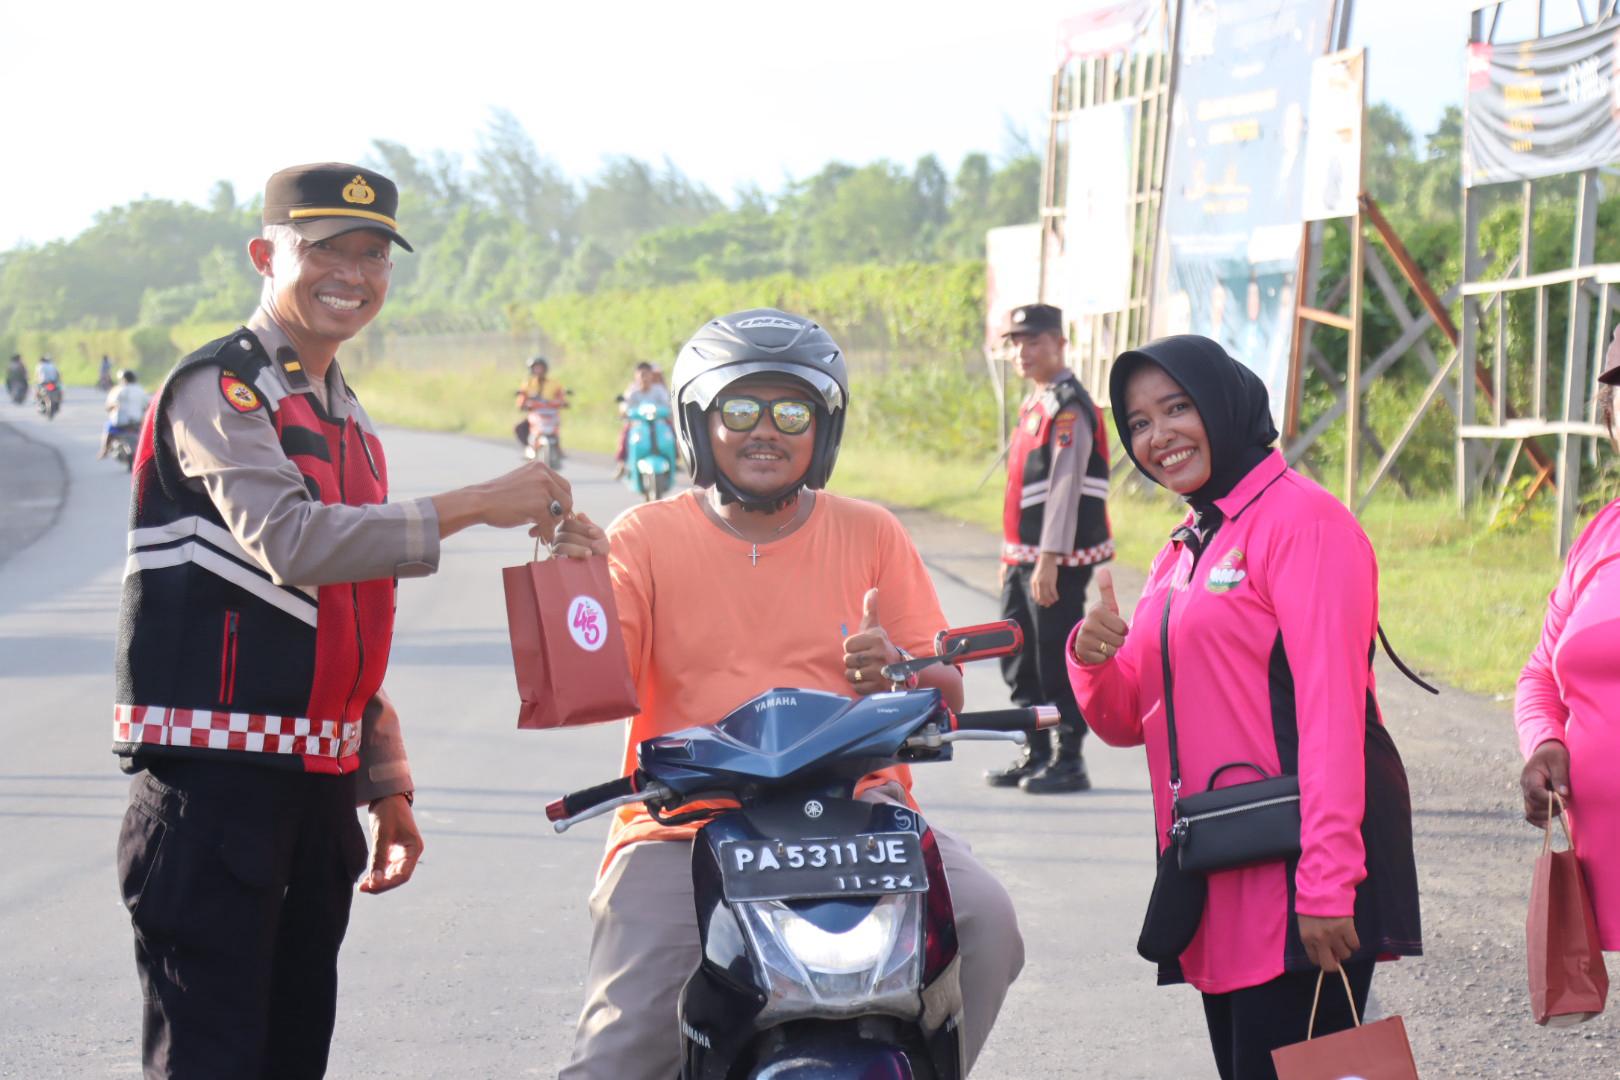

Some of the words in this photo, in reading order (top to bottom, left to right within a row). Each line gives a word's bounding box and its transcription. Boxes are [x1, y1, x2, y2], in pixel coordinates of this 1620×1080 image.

[573, 602, 600, 645] 45
[754, 696, 798, 713] YAMAHA
[735, 846, 781, 872] PA
[786, 842, 859, 868] 5311
[867, 840, 907, 864] JE
